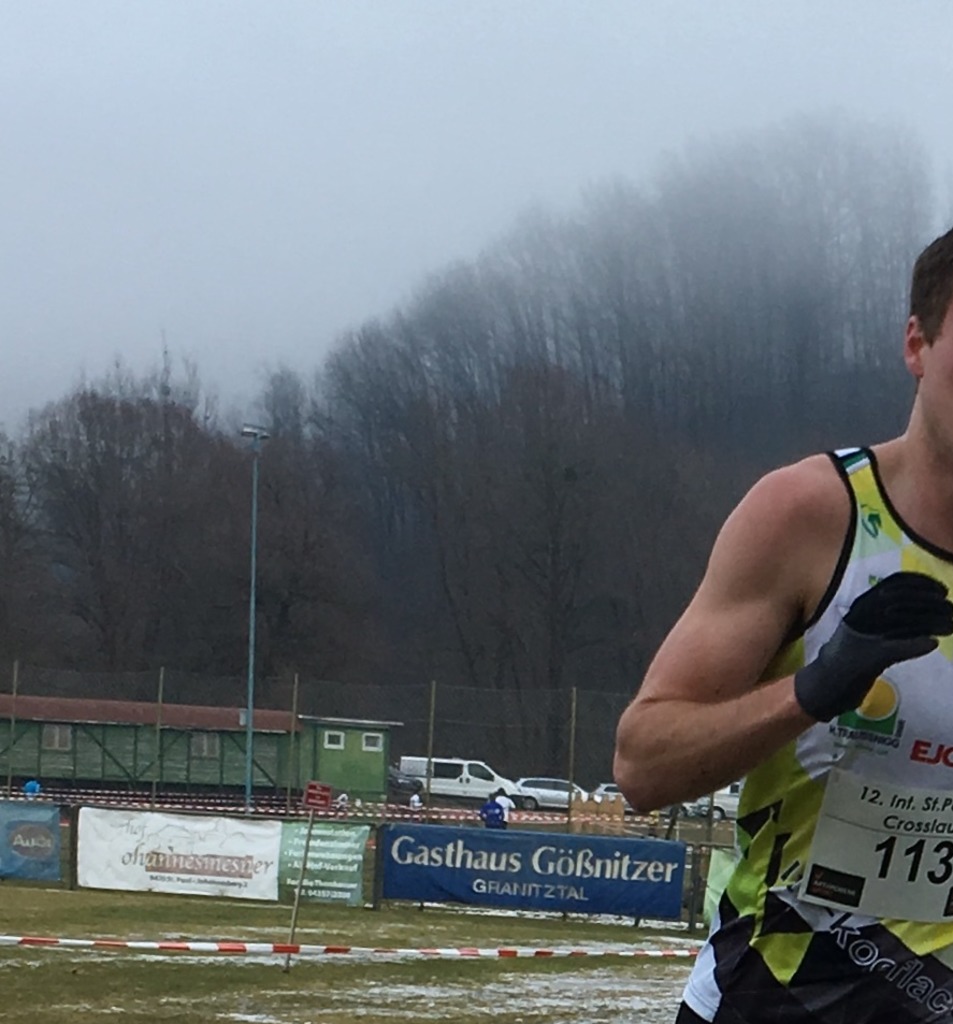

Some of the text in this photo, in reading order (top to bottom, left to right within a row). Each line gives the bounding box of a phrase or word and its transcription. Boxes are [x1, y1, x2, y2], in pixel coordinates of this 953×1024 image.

[860, 786, 883, 806] 12.
[890, 794, 916, 811] Int.
[391, 835, 679, 883] Gasthaus Gößnitzer
[472, 878, 589, 901] GRANITZTAL
